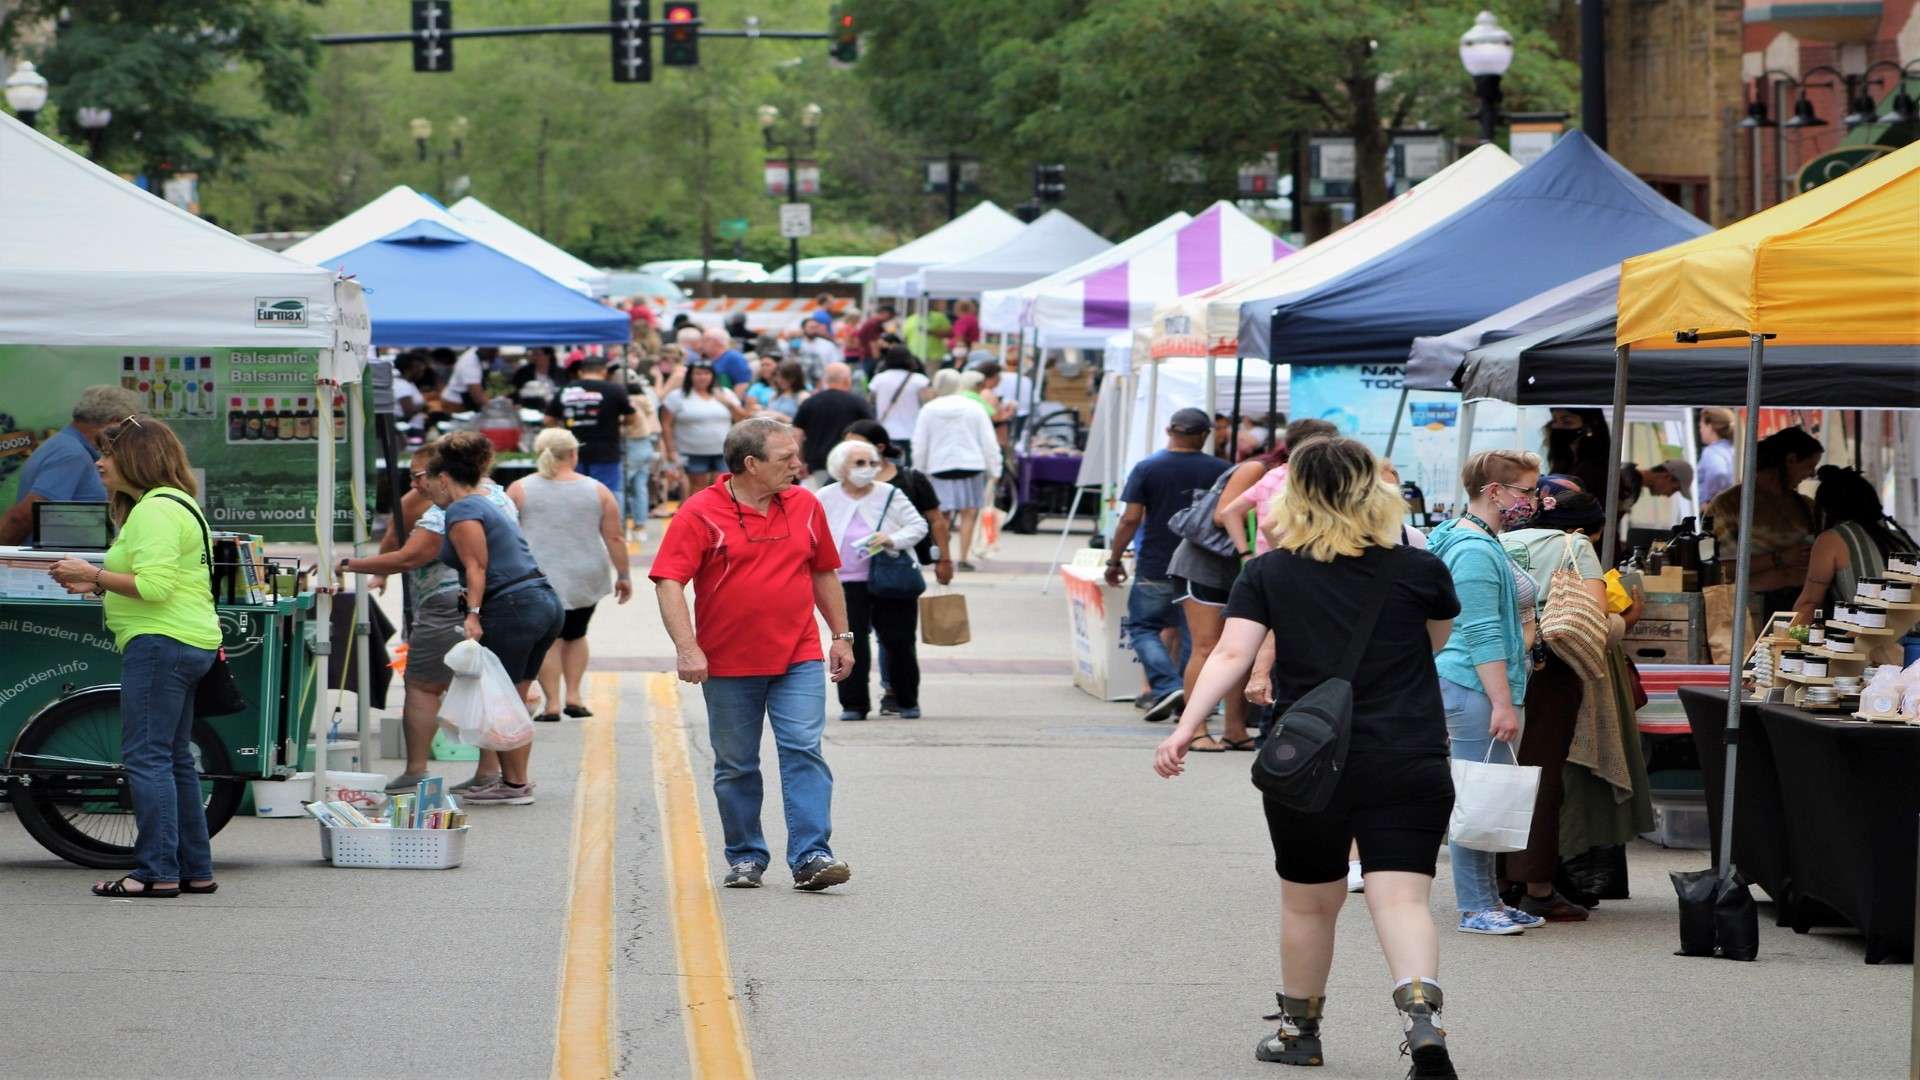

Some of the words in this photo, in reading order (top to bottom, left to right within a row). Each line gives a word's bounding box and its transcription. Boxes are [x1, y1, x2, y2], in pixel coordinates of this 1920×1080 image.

[257, 309, 302, 321] Eurmax
[230, 351, 308, 364] Balsamic
[230, 370, 308, 382] Balsamic
[0, 435, 31, 450] OODS
[213, 507, 257, 520] Olive
[260, 506, 306, 520] wood
[22, 621, 79, 641] Borden
